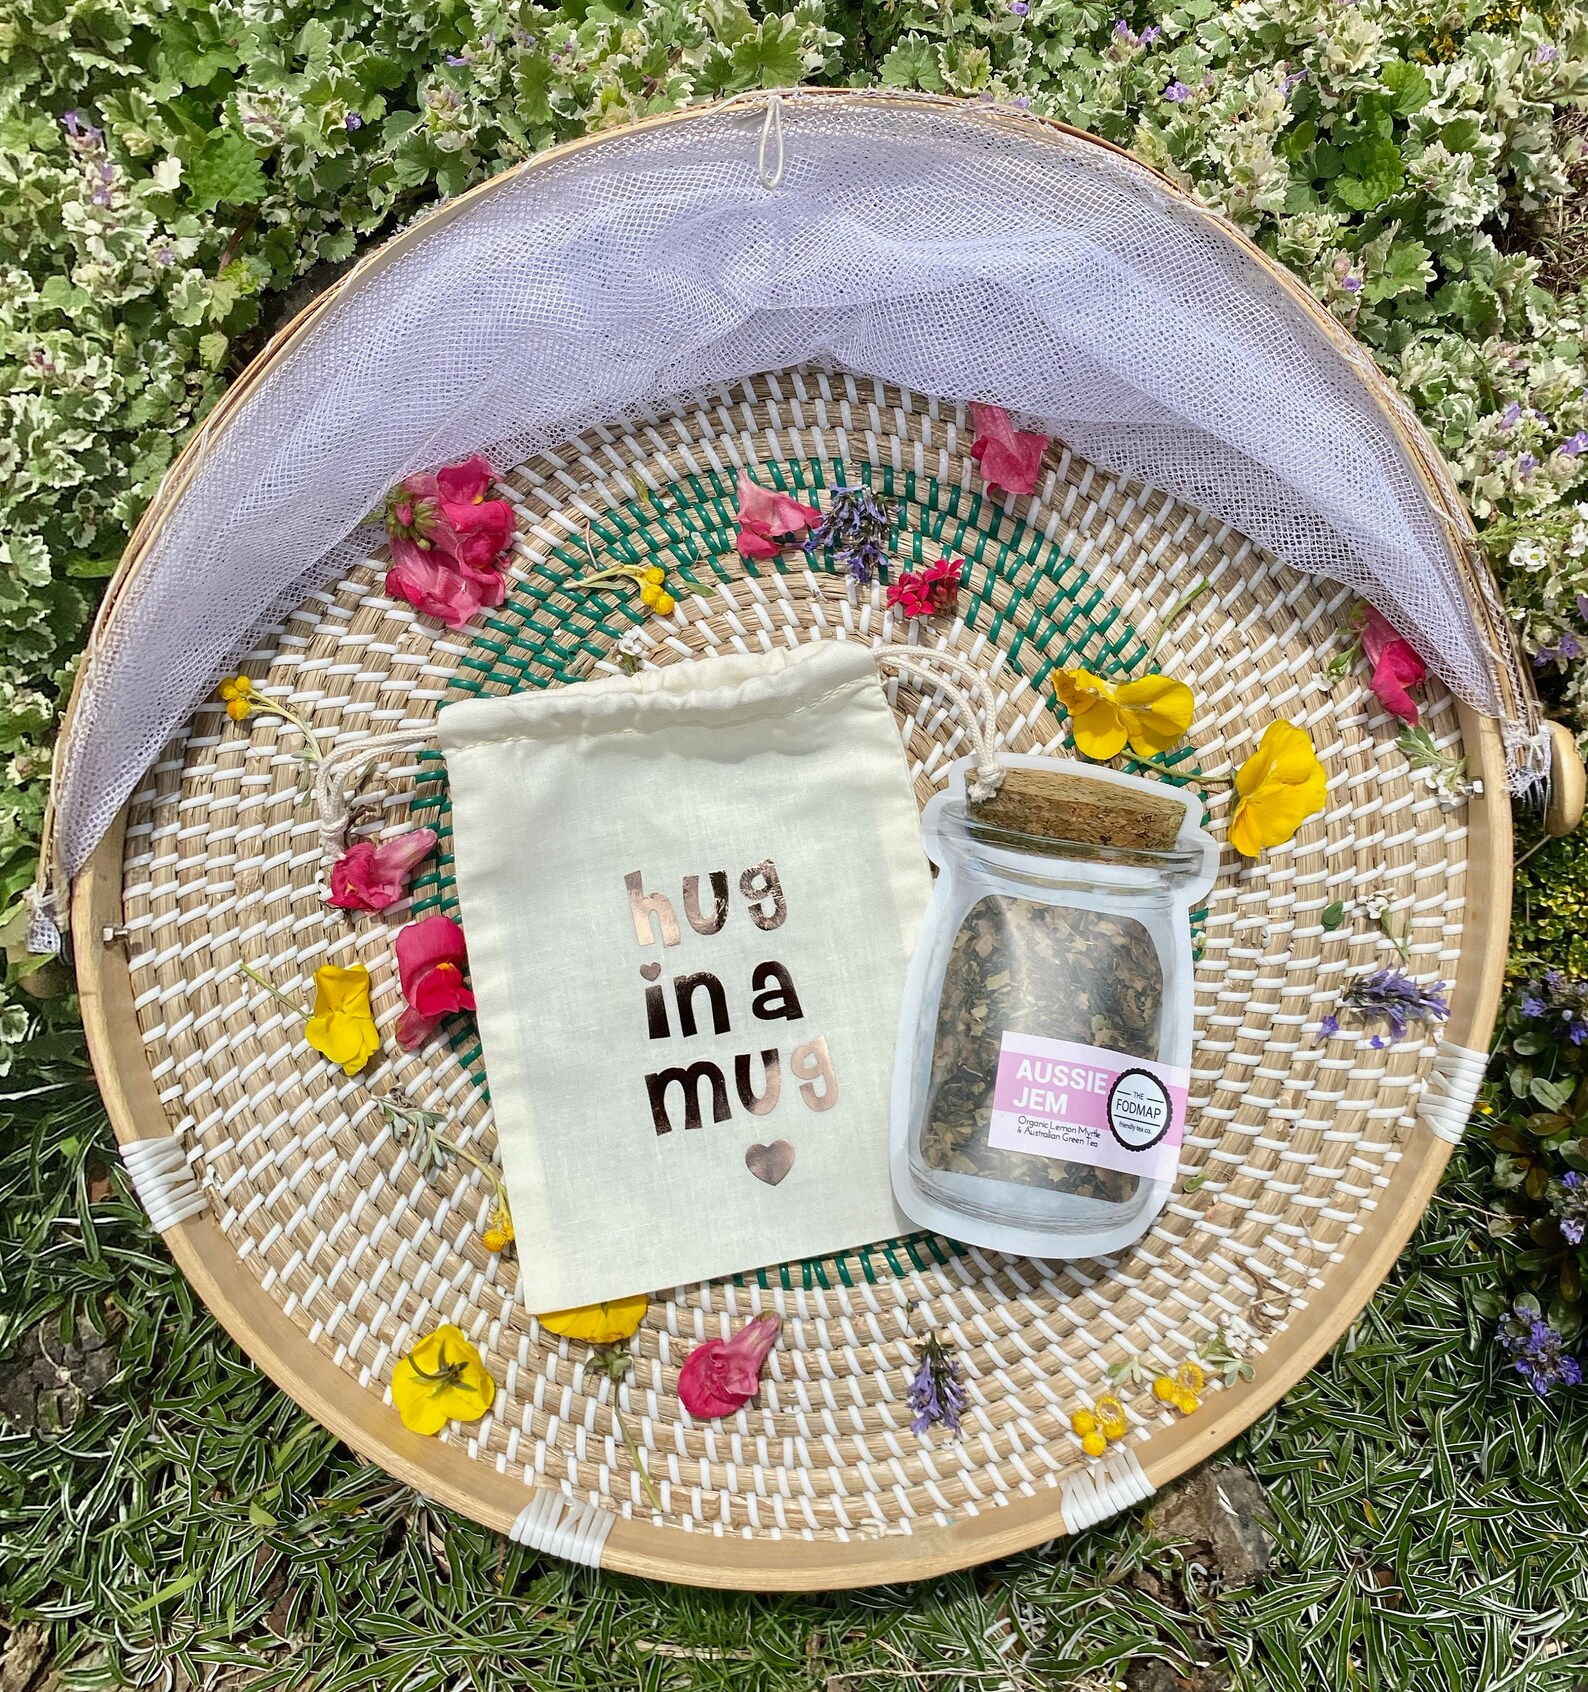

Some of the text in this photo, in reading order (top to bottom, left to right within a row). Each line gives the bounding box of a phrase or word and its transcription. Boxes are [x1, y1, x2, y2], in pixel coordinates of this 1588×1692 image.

[624, 858, 788, 948] hug
[639, 960, 804, 1039] in a
[644, 1034, 839, 1136] mug
[1015, 1058, 1109, 1095] AUSSIE
[1012, 1087, 1069, 1115] JEM
[1116, 1098, 1162, 1120] FODMAP
[1133, 1091, 1145, 1101] THE
[1018, 1115, 1101, 1139] Organic Lemon Myrtle
[1023, 1126, 1061, 1141] Australian
[1061, 1133, 1085, 1145] Green
[1086, 1136, 1099, 1148] Tea
[1119, 1121, 1136, 1132] friendly
